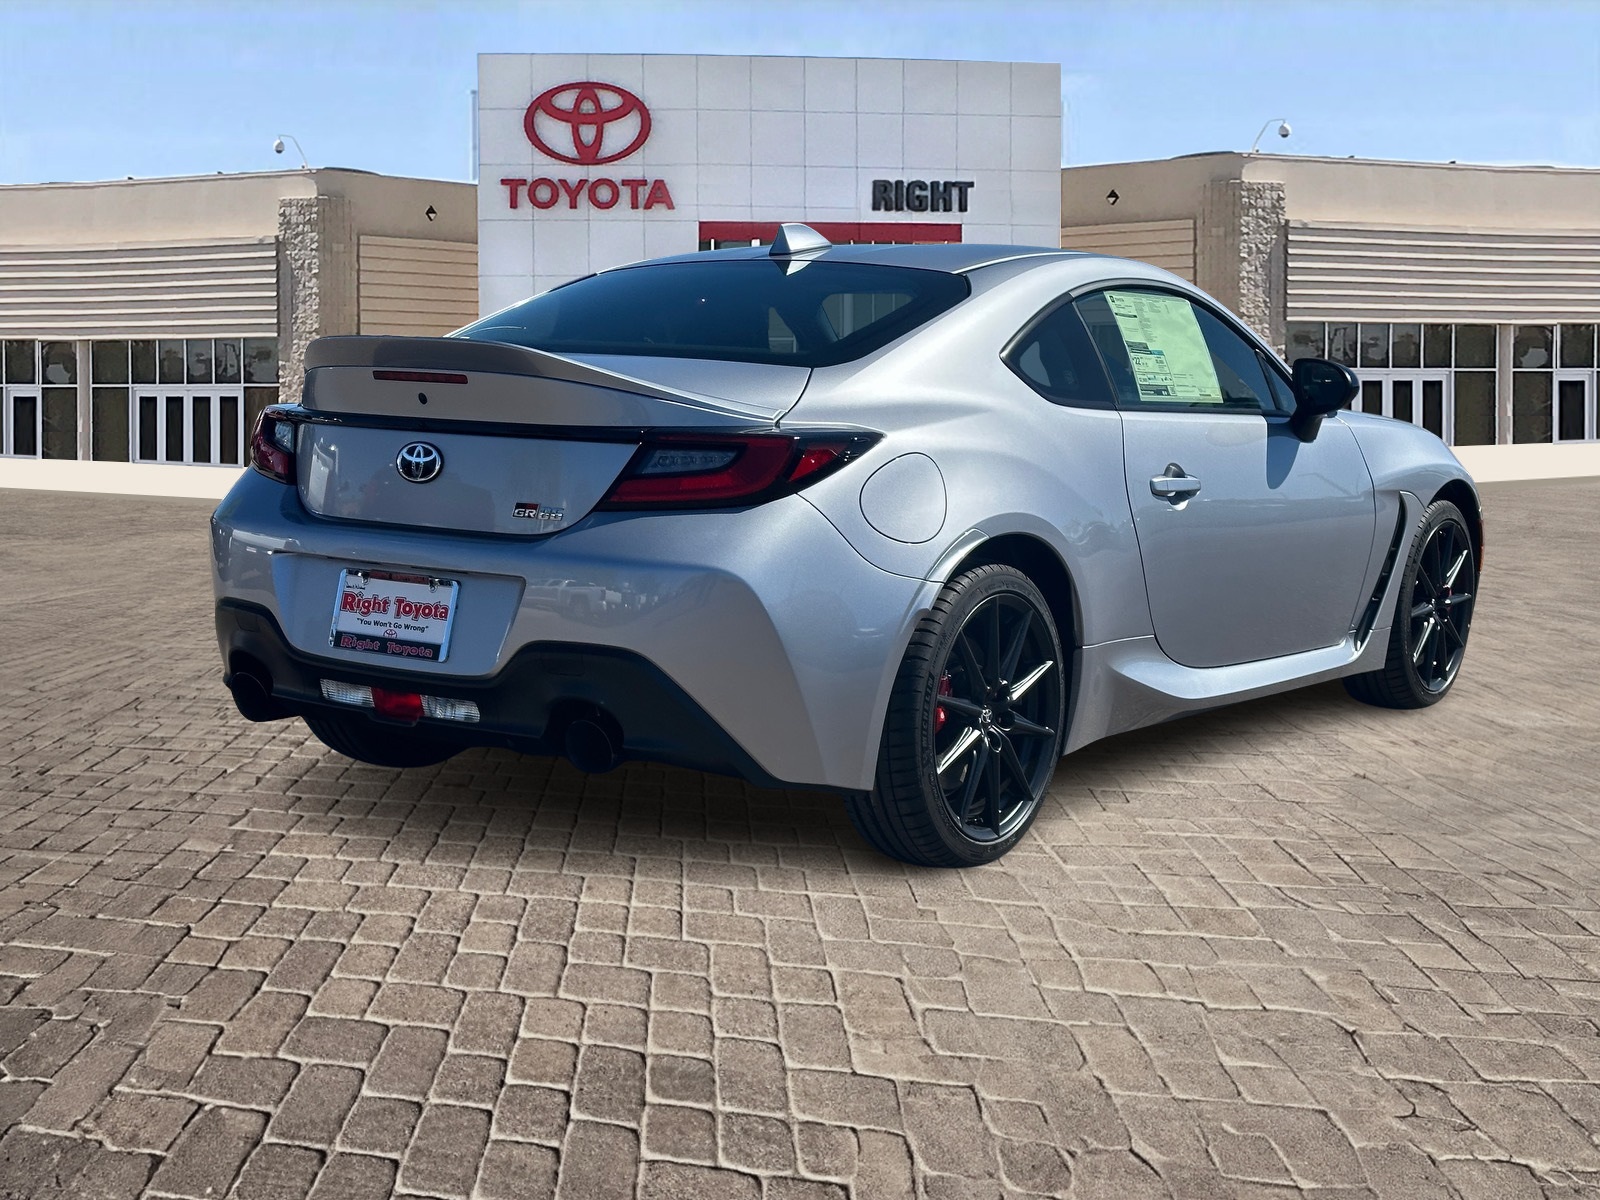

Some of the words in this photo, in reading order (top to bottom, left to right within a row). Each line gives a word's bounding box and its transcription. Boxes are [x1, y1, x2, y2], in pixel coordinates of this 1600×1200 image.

[500, 178, 675, 211] TOYOTA
[872, 180, 974, 212] RIGHT
[340, 590, 391, 617] Right
[394, 596, 450, 621] Toyota
[357, 618, 372, 626] "You
[373, 619, 392, 628] Won't
[404, 624, 429, 633] Wrong"
[340, 635, 380, 652] Right
[387, 641, 433, 658] Toyota
